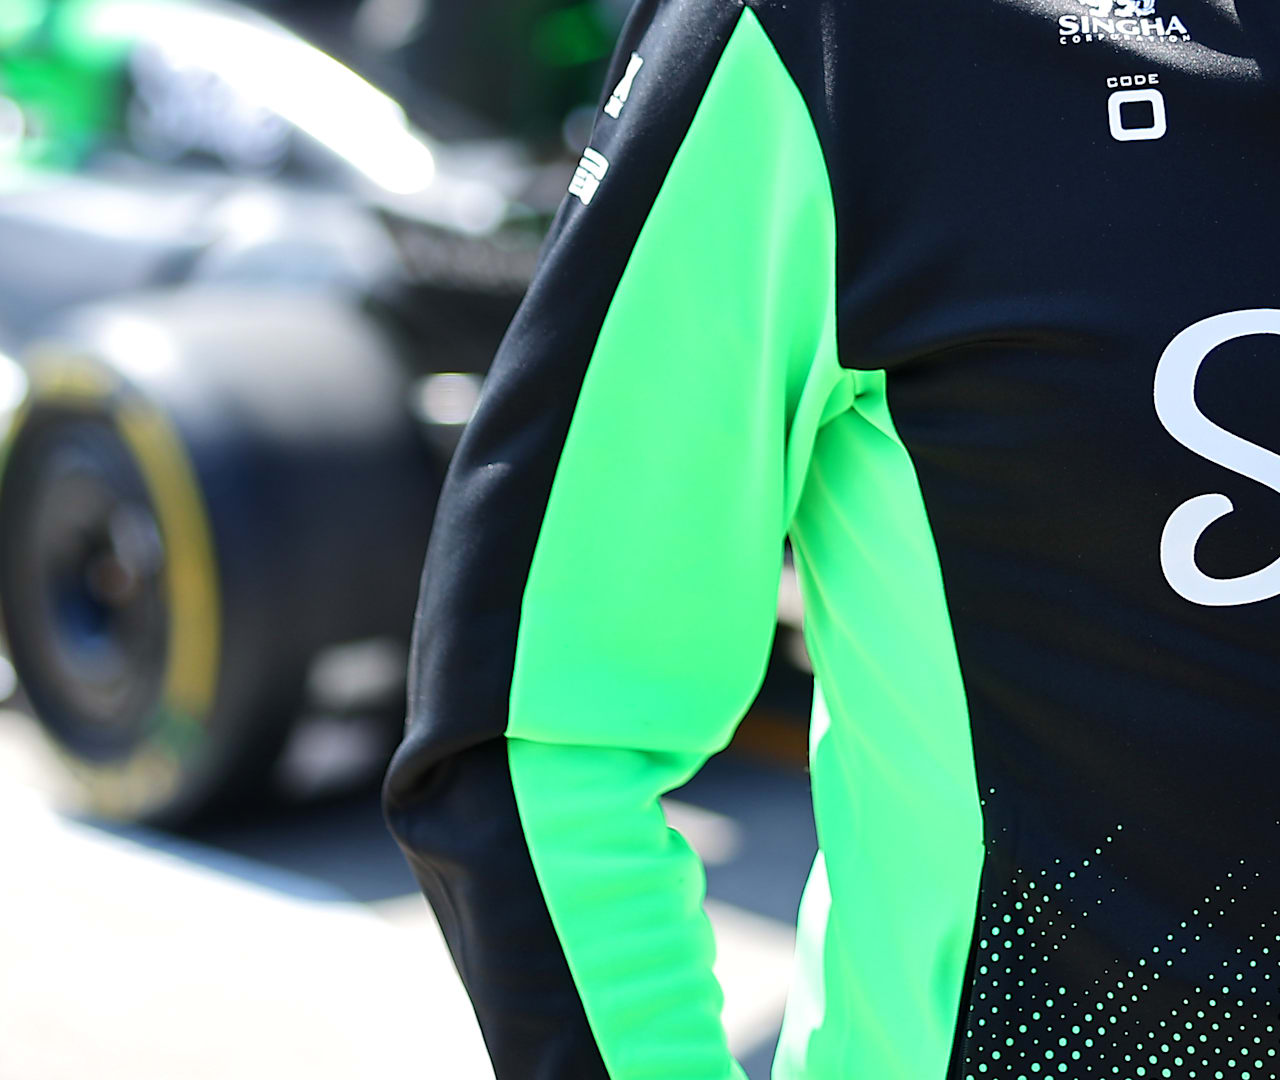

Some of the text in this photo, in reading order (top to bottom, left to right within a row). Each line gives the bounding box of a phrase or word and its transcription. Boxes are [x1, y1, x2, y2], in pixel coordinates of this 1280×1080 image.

[1058, 14, 1188, 37] SINGHA
[1058, 33, 1192, 45] CORPORATION
[1106, 73, 1160, 89] CODE
